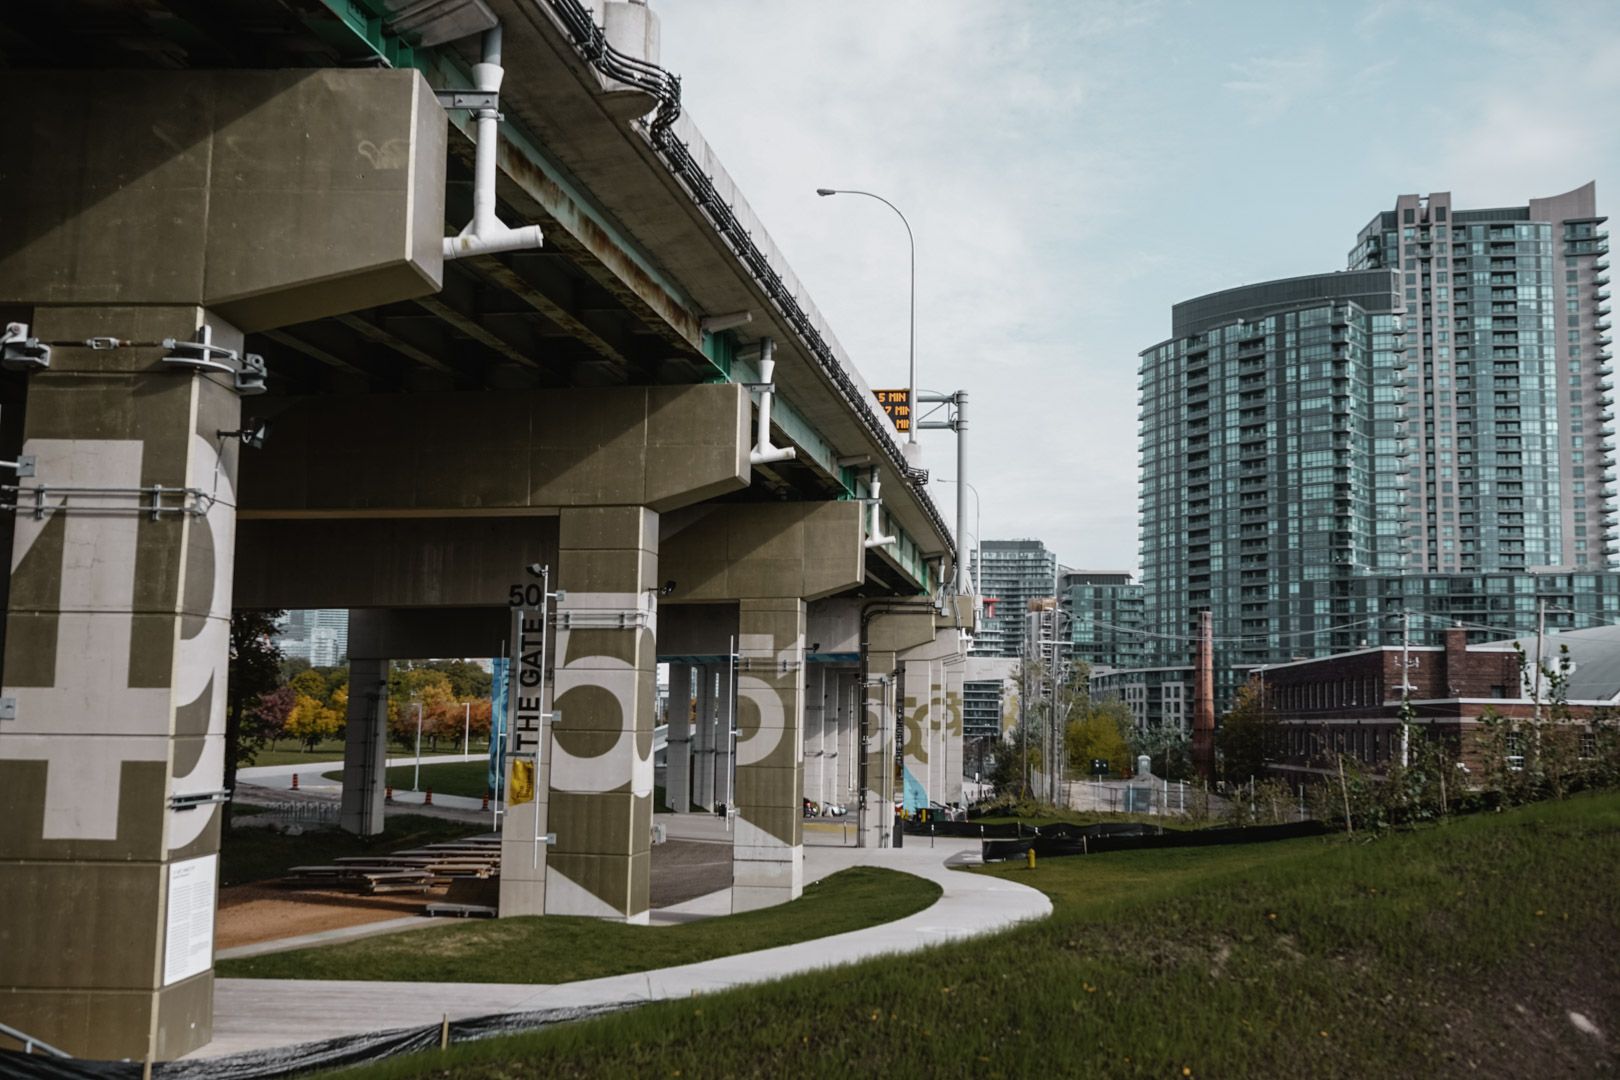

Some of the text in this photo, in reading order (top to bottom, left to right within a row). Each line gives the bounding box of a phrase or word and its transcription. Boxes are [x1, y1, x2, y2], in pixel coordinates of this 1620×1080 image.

[878, 392, 906, 402] 5 MIN
[509, 583, 542, 607] 50
[520, 618, 543, 687] GATE
[517, 697, 540, 751] THE
